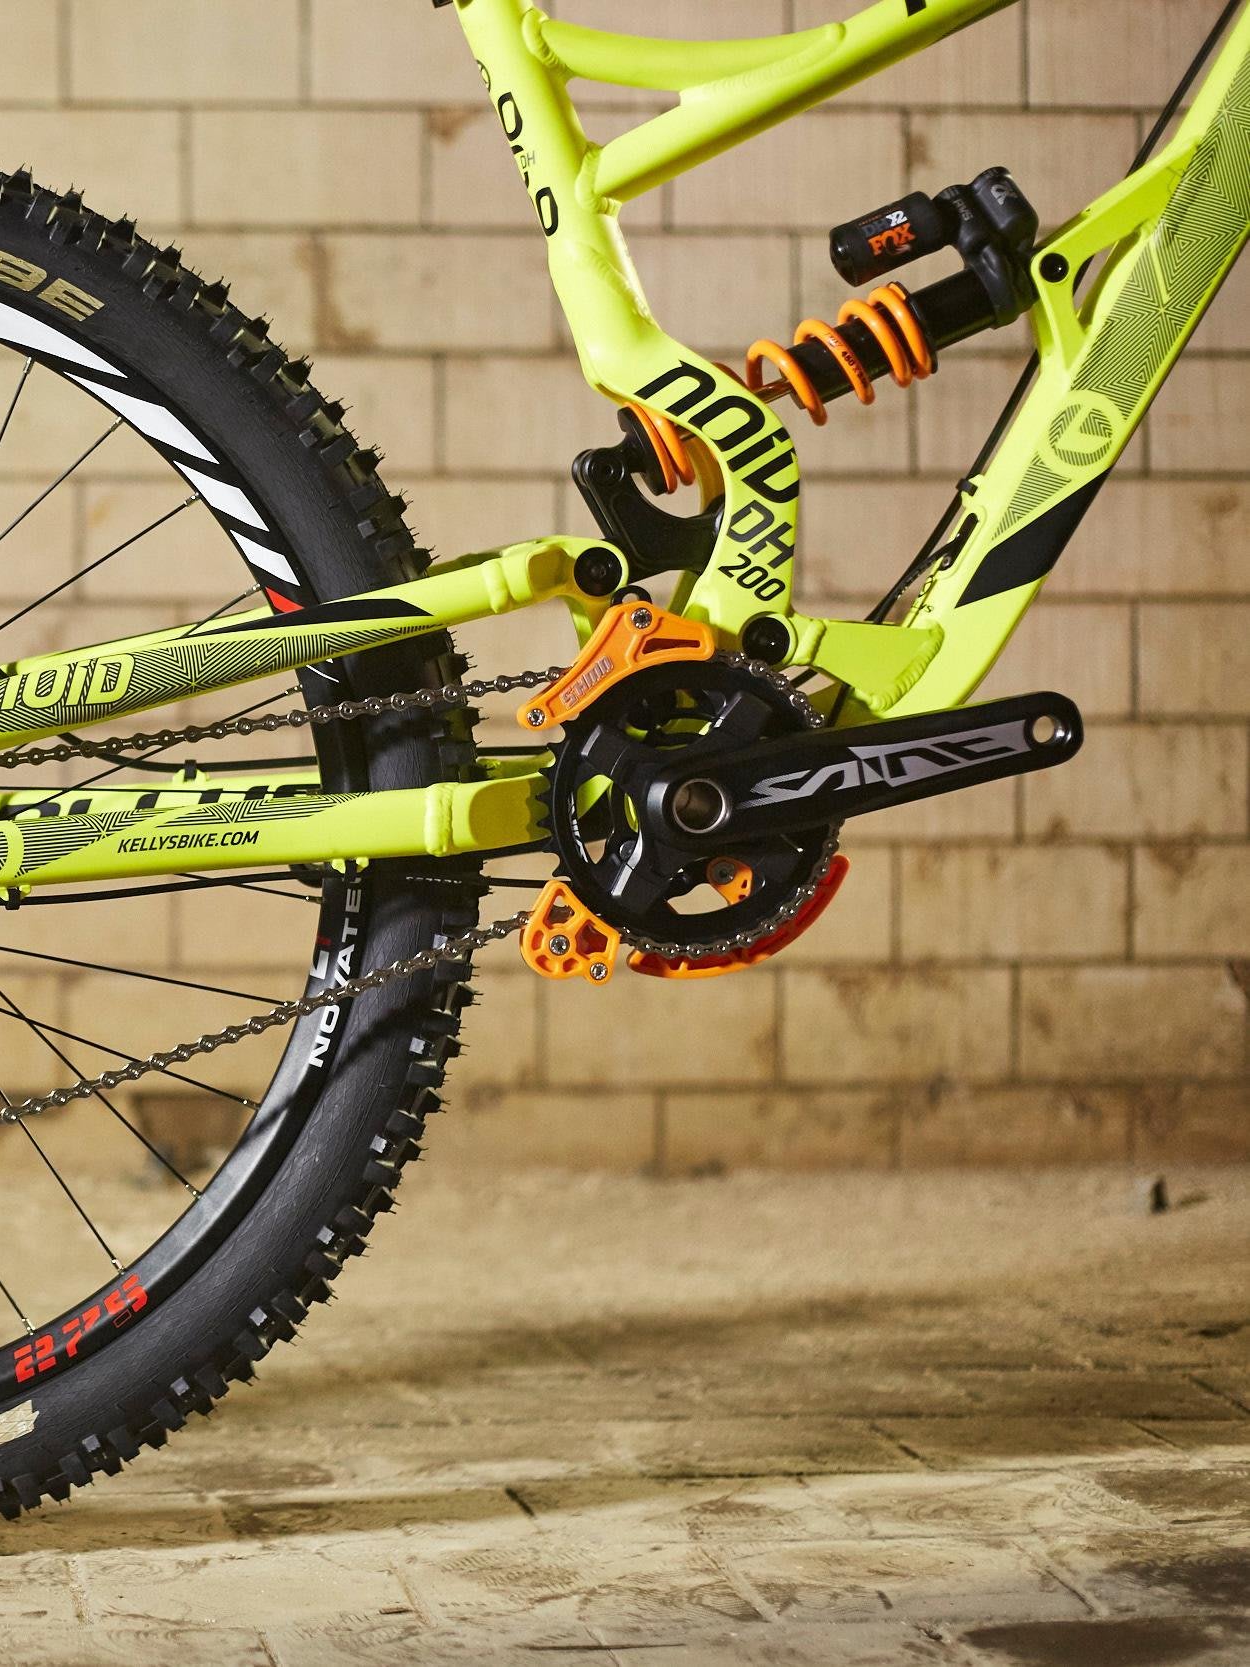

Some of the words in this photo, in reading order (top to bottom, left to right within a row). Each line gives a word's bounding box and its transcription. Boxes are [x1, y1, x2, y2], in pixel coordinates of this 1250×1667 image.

[868, 222, 916, 256] FOX
[727, 500, 794, 569] DH
[718, 553, 786, 601] 200
[117, 830, 260, 854] KELLYSBIKE.COM
